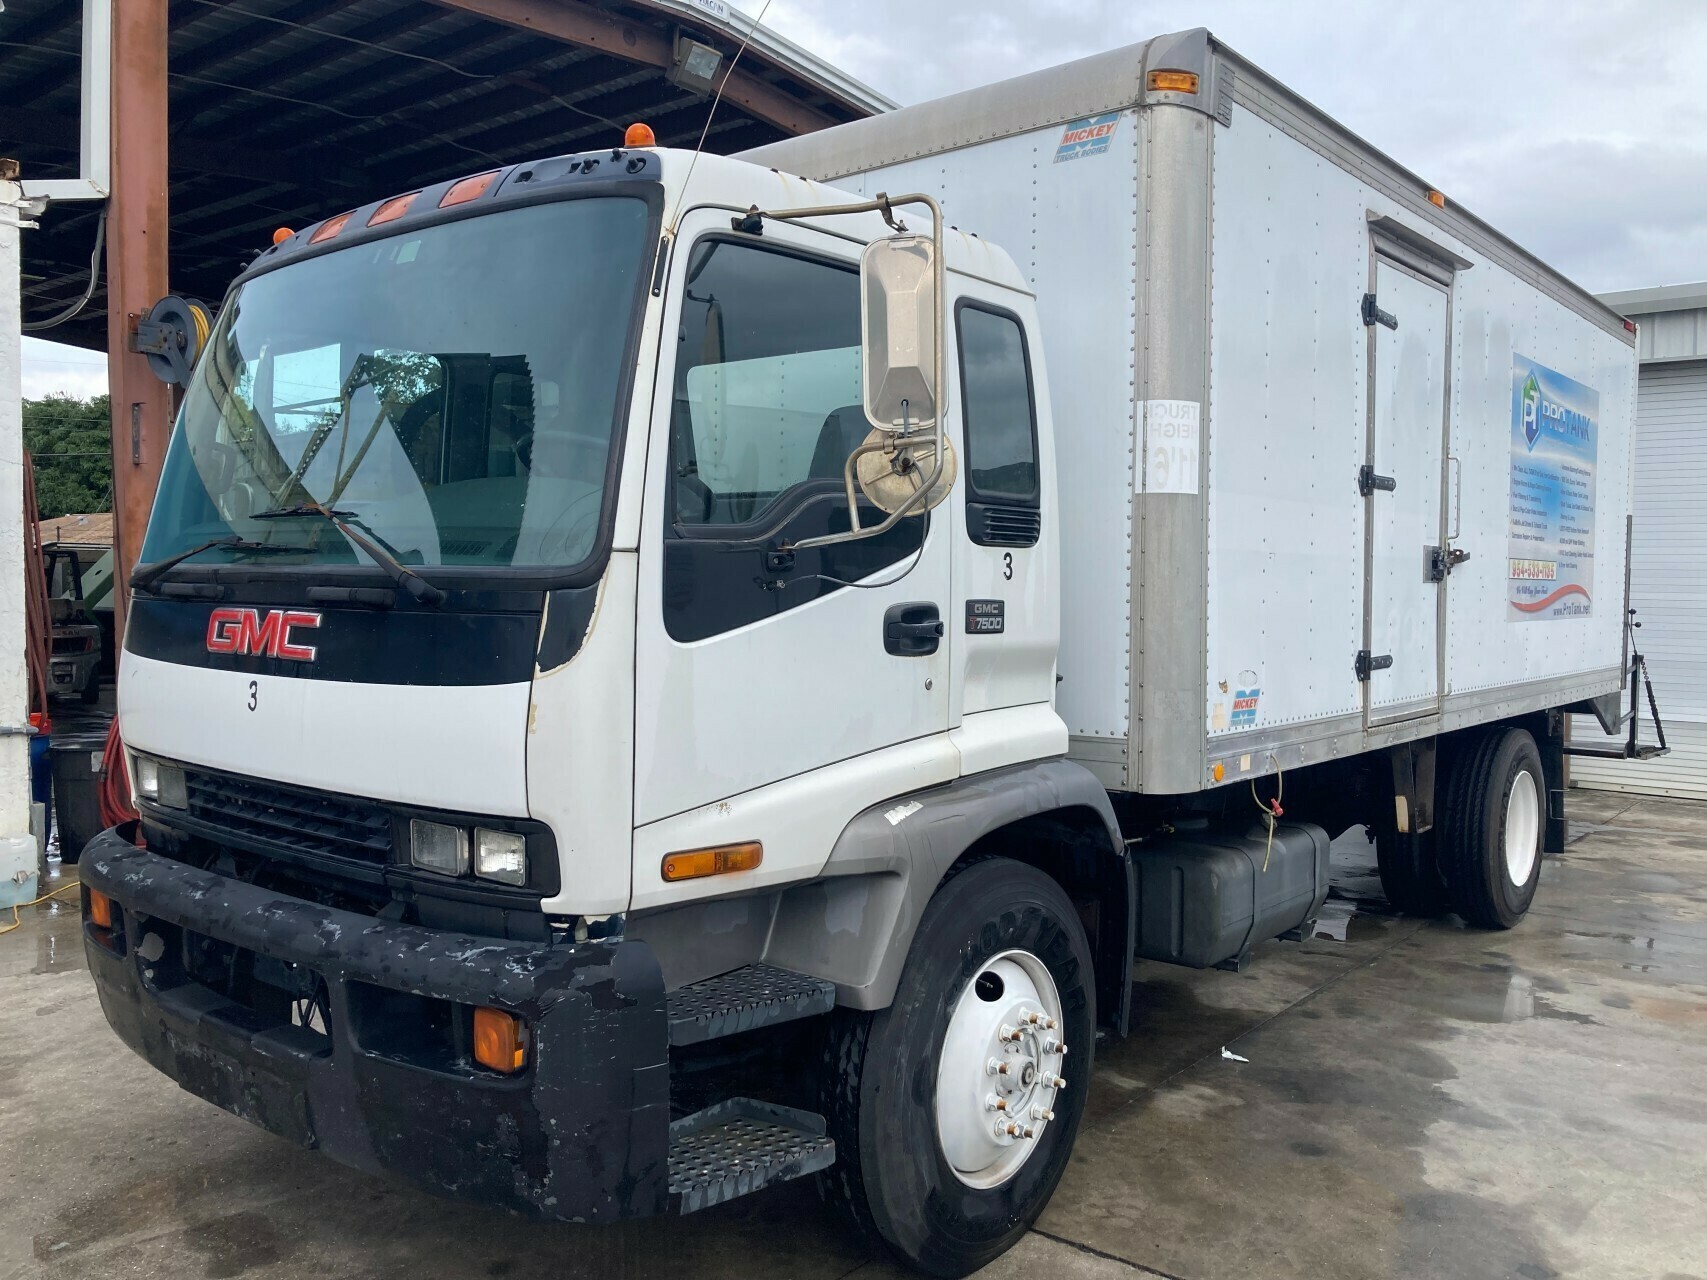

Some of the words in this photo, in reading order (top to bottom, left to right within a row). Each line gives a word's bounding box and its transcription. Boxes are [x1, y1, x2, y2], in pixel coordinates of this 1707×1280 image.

[1062, 123, 1116, 145] MICKEY
[1056, 150, 1080, 163] TRUCK
[1080, 145, 1109, 157] BODIES
[1003, 552, 1013, 580] 3
[974, 603, 999, 614] GMC
[969, 617, 1003, 630] T7500
[207, 607, 322, 661] GMC
[248, 680, 258, 712] 3
[1233, 698, 1259, 710] MICKEY
